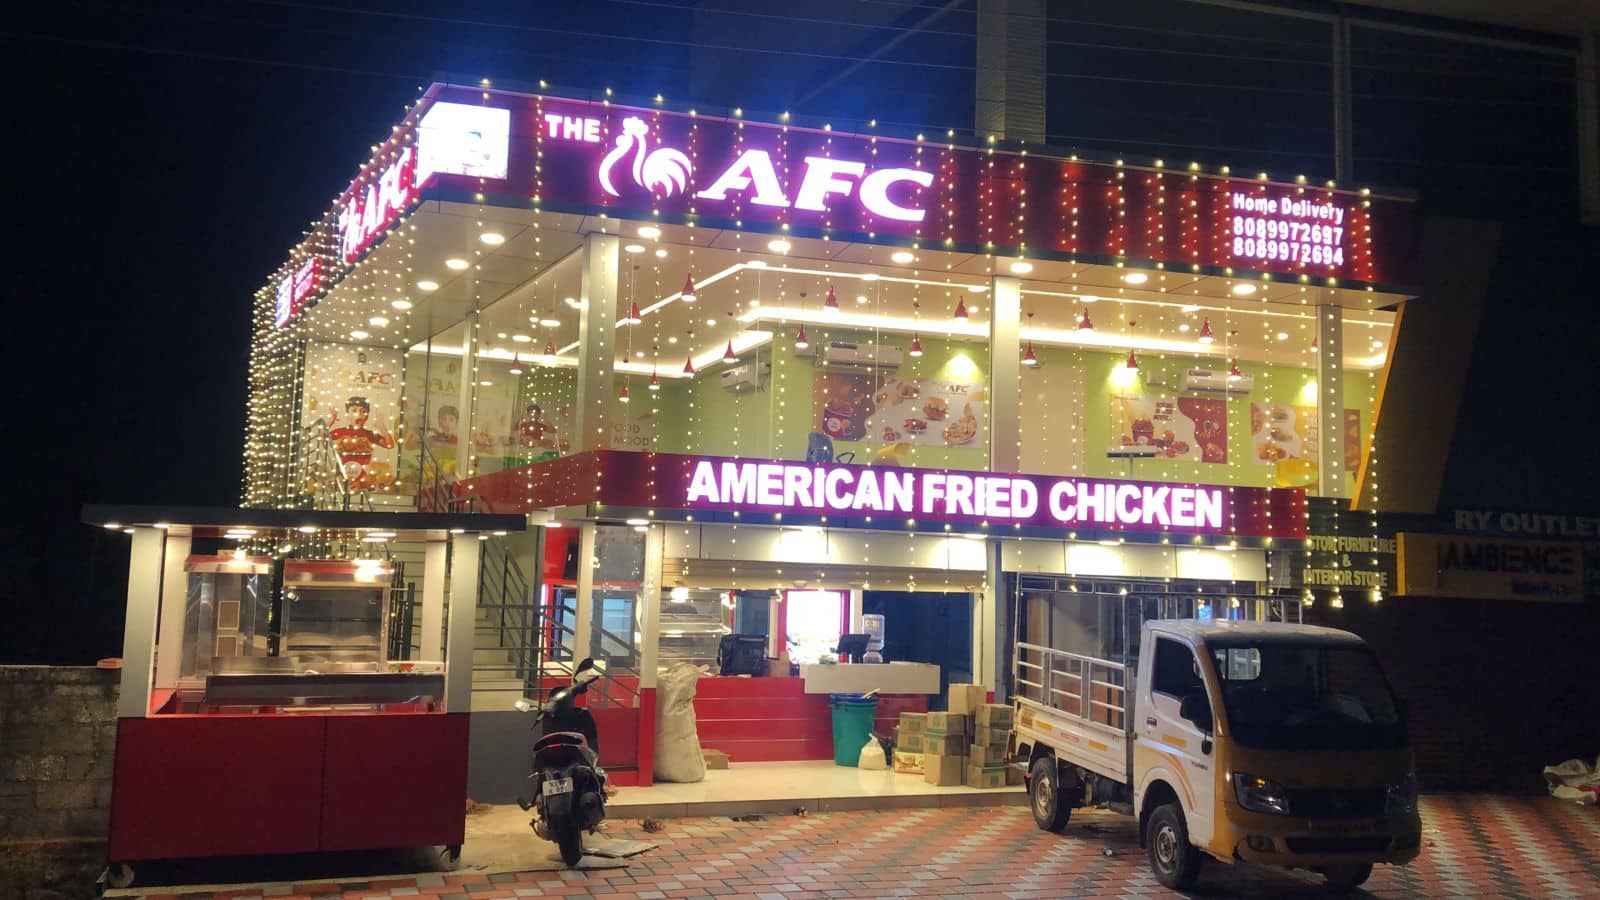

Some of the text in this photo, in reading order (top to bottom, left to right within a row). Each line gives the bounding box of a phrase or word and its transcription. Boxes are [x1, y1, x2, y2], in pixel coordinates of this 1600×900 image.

[545, 113, 601, 143] THE
[698, 148, 935, 222] AFC
[1233, 192, 1344, 225] Home Delivery
[1233, 216, 1343, 246] 8089972697
[1233, 237, 1344, 265] 8089972694
[353, 370, 391, 385] AFC
[948, 384, 968, 393] AFC
[614, 423, 641, 433] OOD
[687, 460, 1223, 528] AMERICAN FRIED CHICKEN
[1338, 536, 1396, 554] FURNITURE
[1445, 542, 1575, 574] AMBIENCE
[1342, 553, 1352, 567] &
[1303, 568, 1387, 587] INTERIOR STORE
